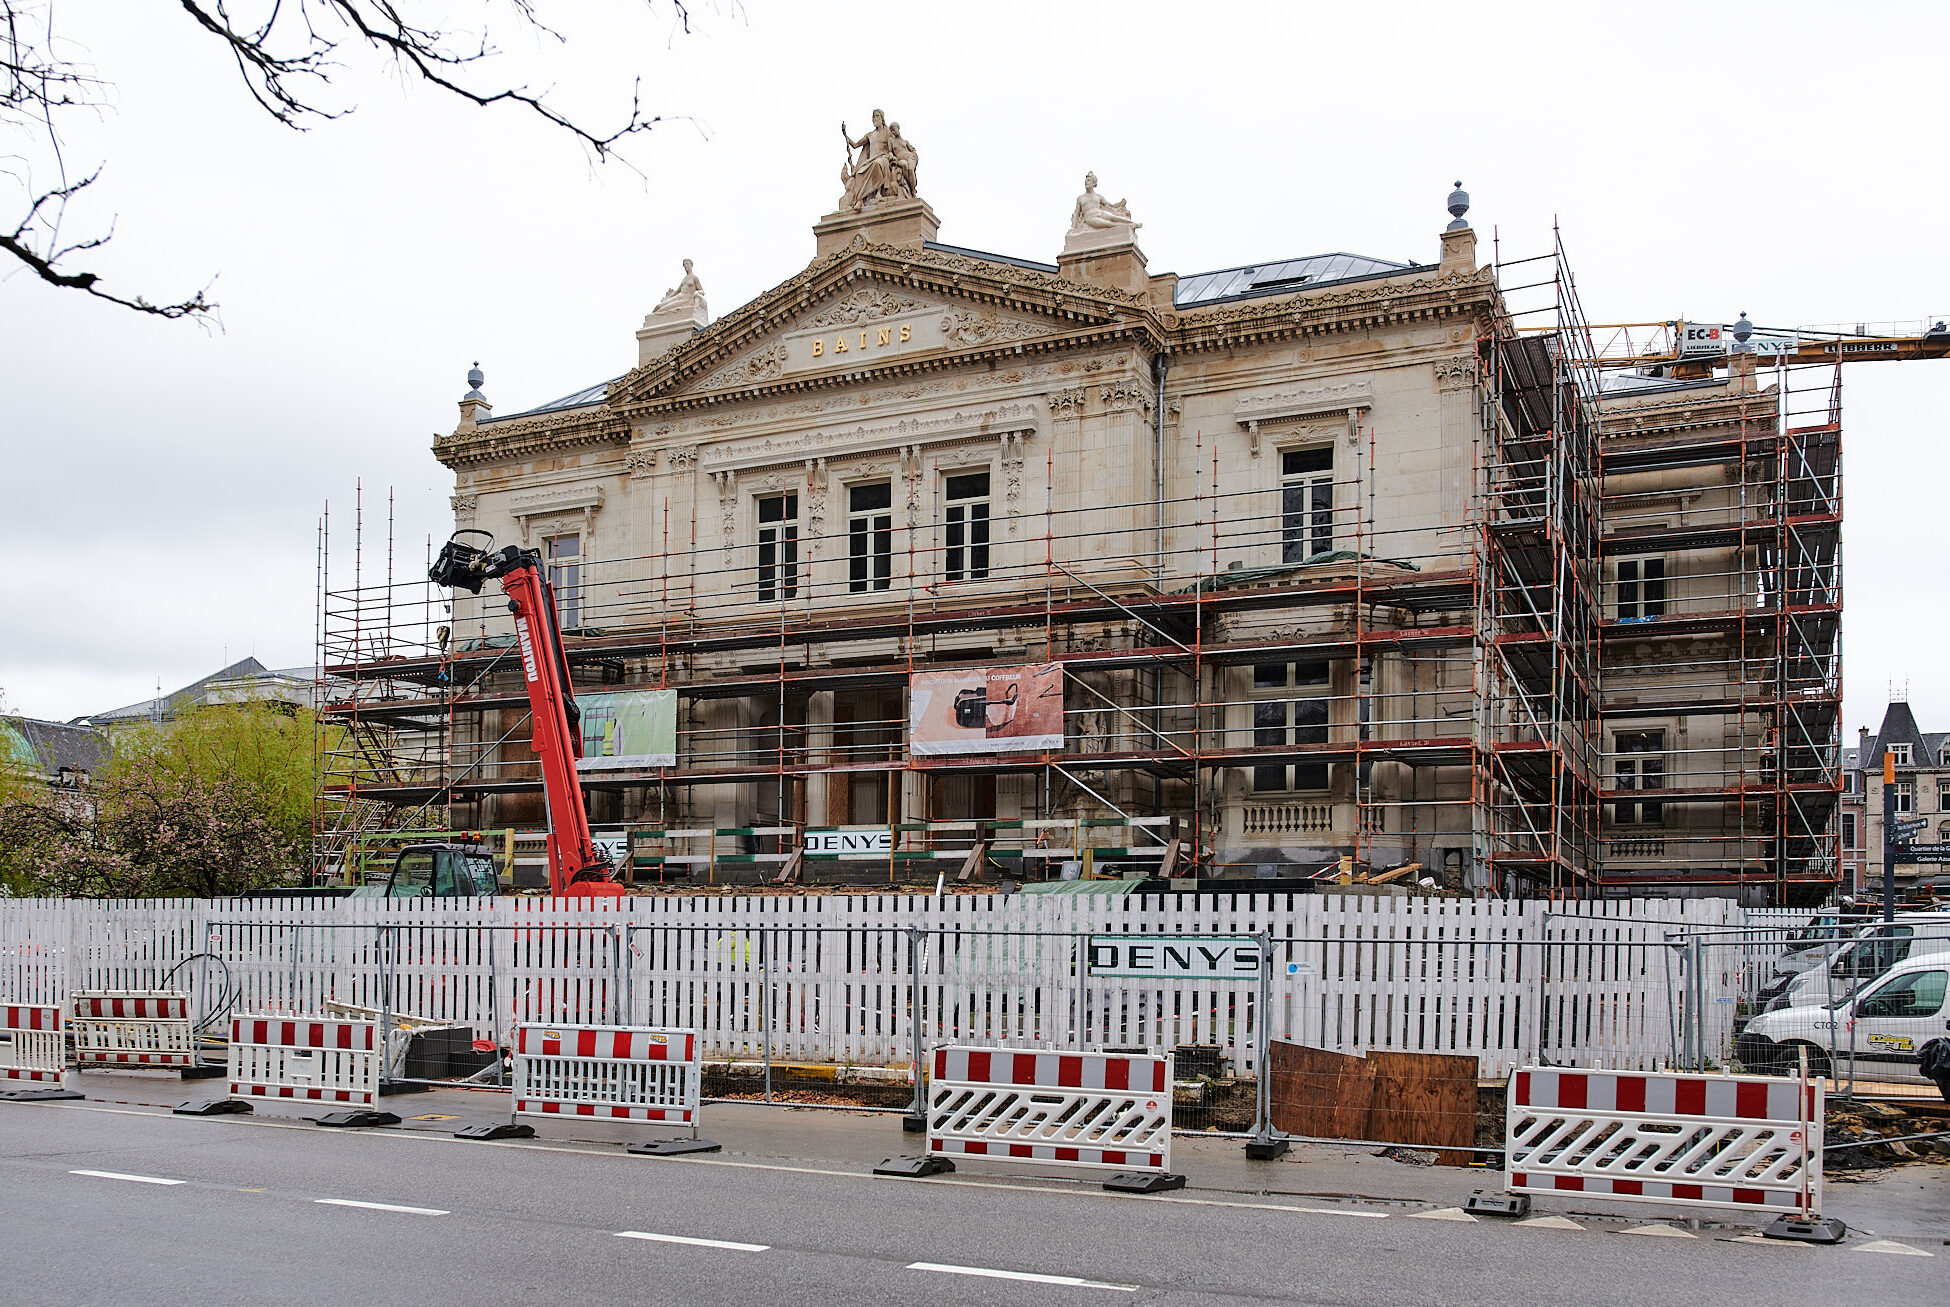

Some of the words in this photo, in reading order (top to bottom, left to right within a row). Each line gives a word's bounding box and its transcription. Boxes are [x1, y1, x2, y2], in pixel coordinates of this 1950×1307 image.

[812, 323, 912, 357] BAINS
[1687, 328, 1720, 341] EC-B
[516, 617, 539, 682] MANITOU
[804, 834, 892, 850] DENYS
[1091, 945, 1260, 971] DENYS
